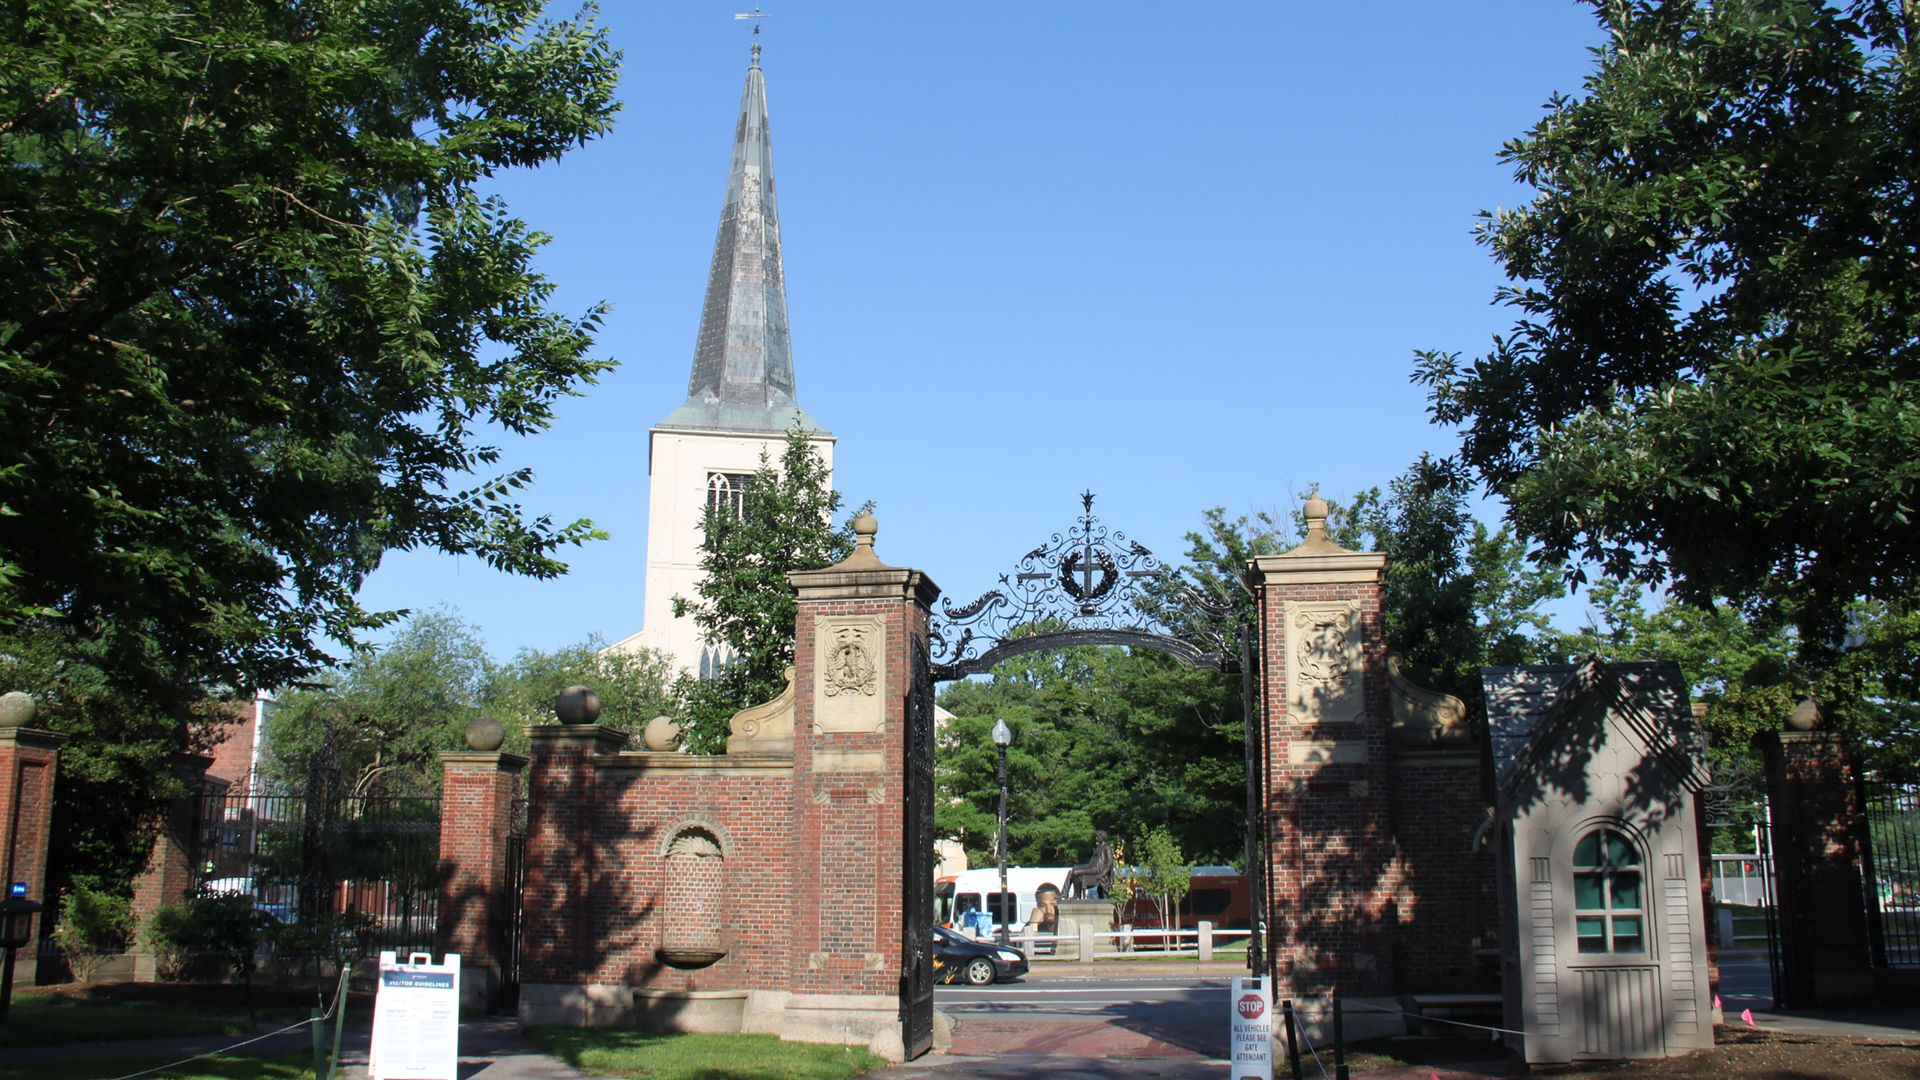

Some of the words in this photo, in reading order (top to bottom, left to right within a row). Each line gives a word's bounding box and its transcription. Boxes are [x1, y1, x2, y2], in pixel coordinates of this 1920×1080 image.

[1239, 1001, 1263, 1012] STOP
[1234, 1024, 1243, 1032] ALL
[1244, 1024, 1270, 1032] VEHICLES
[1236, 1034, 1256, 1042] PLEASE
[1257, 1034, 1267, 1042] SEE
[1244, 1043, 1258, 1051] GATE
[1236, 1053, 1266, 1061] ATTENDANT
